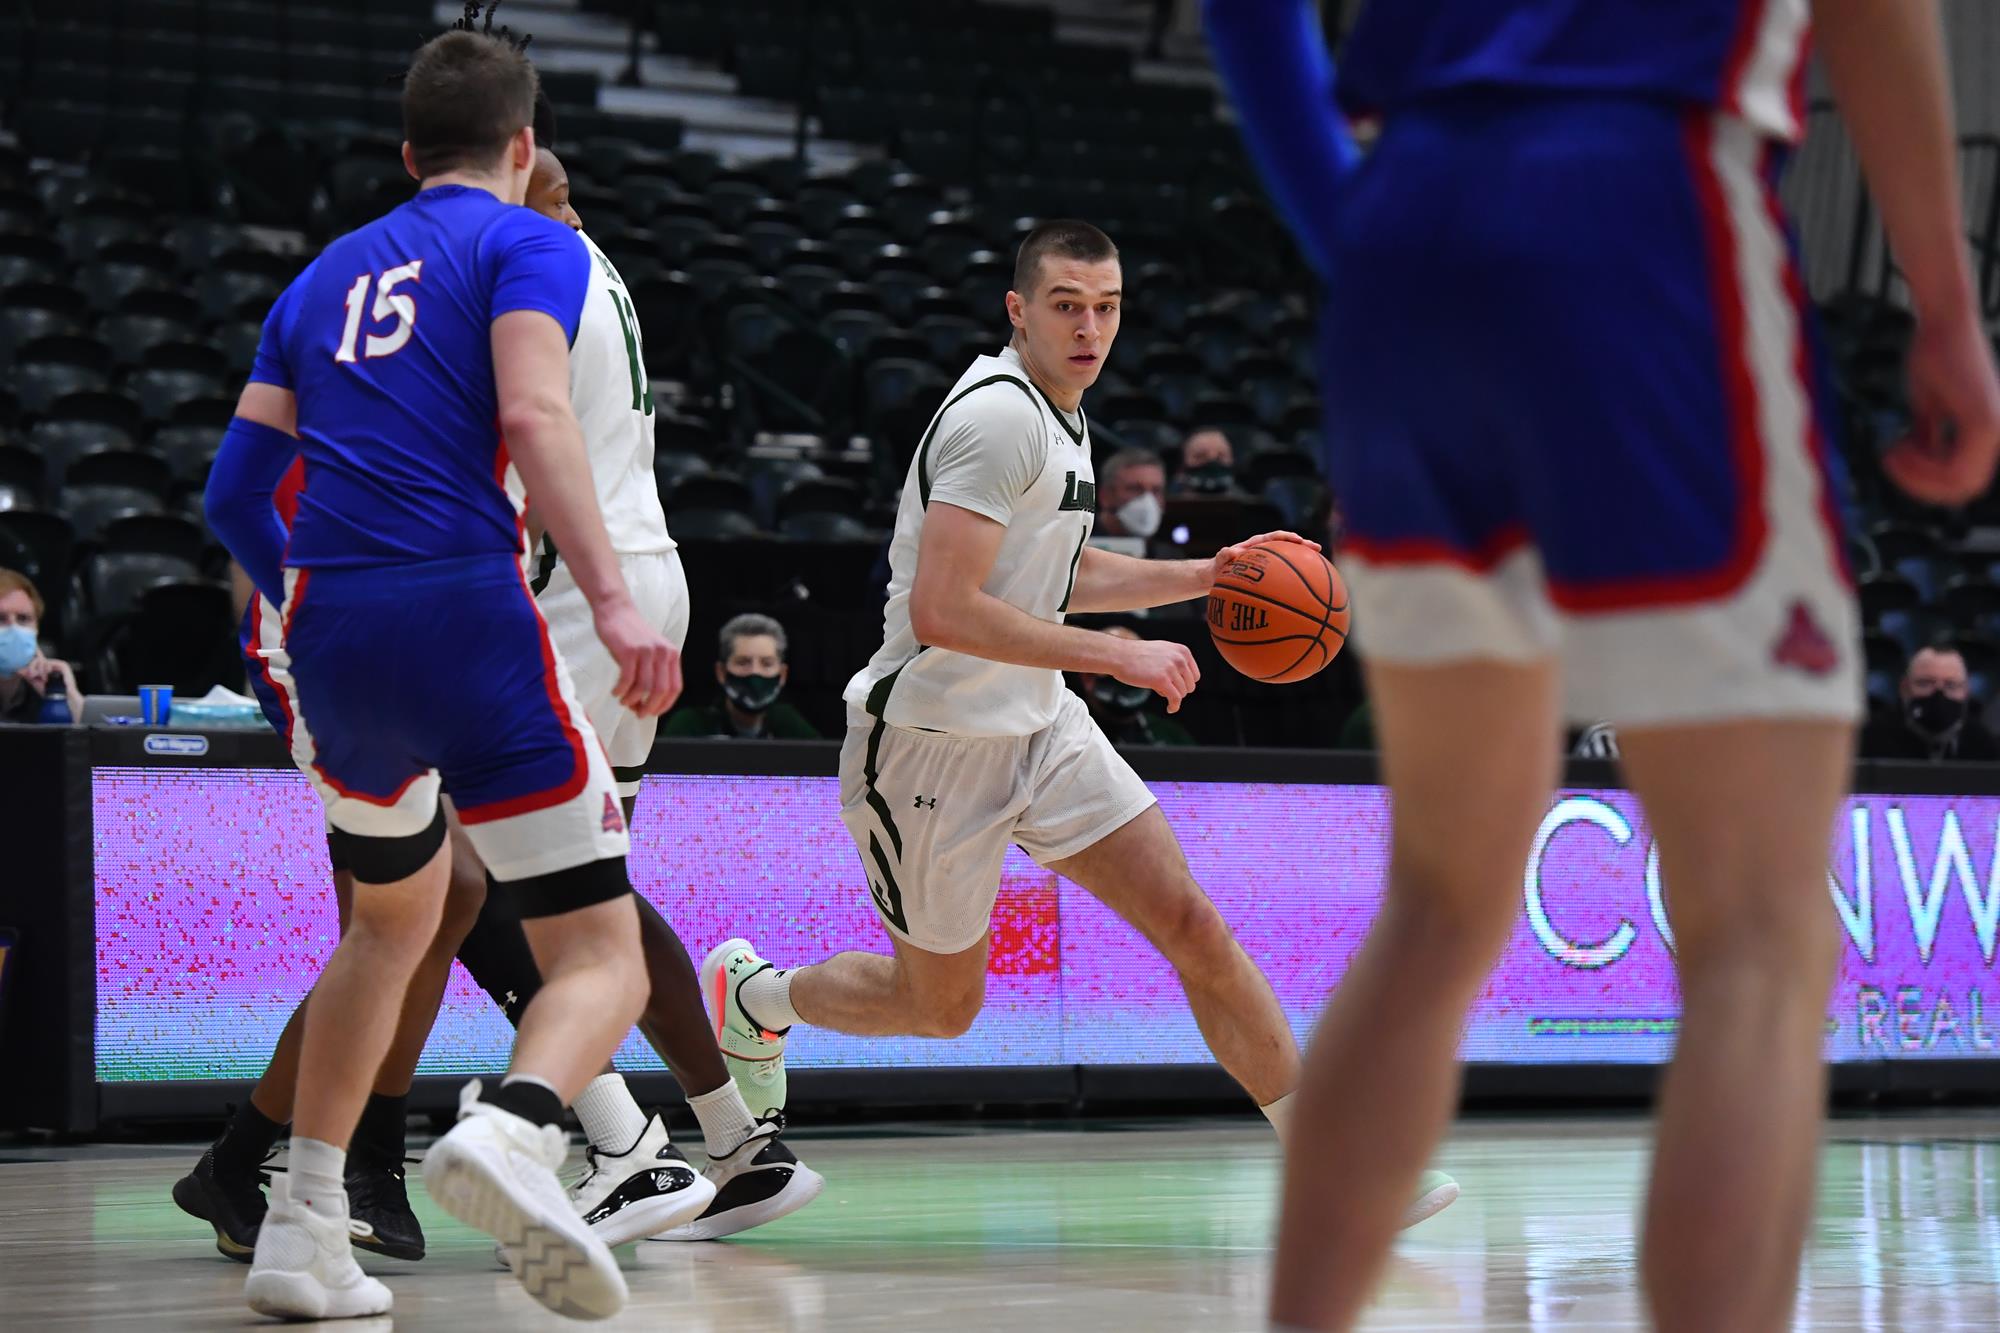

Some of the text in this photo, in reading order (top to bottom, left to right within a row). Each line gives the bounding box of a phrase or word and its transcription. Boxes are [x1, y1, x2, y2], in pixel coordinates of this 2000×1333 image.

[334, 259, 424, 364] 15
[1230, 602, 1269, 632] THE
[1523, 796, 2000, 966] CNW
[1857, 985, 1994, 1050] REAL
